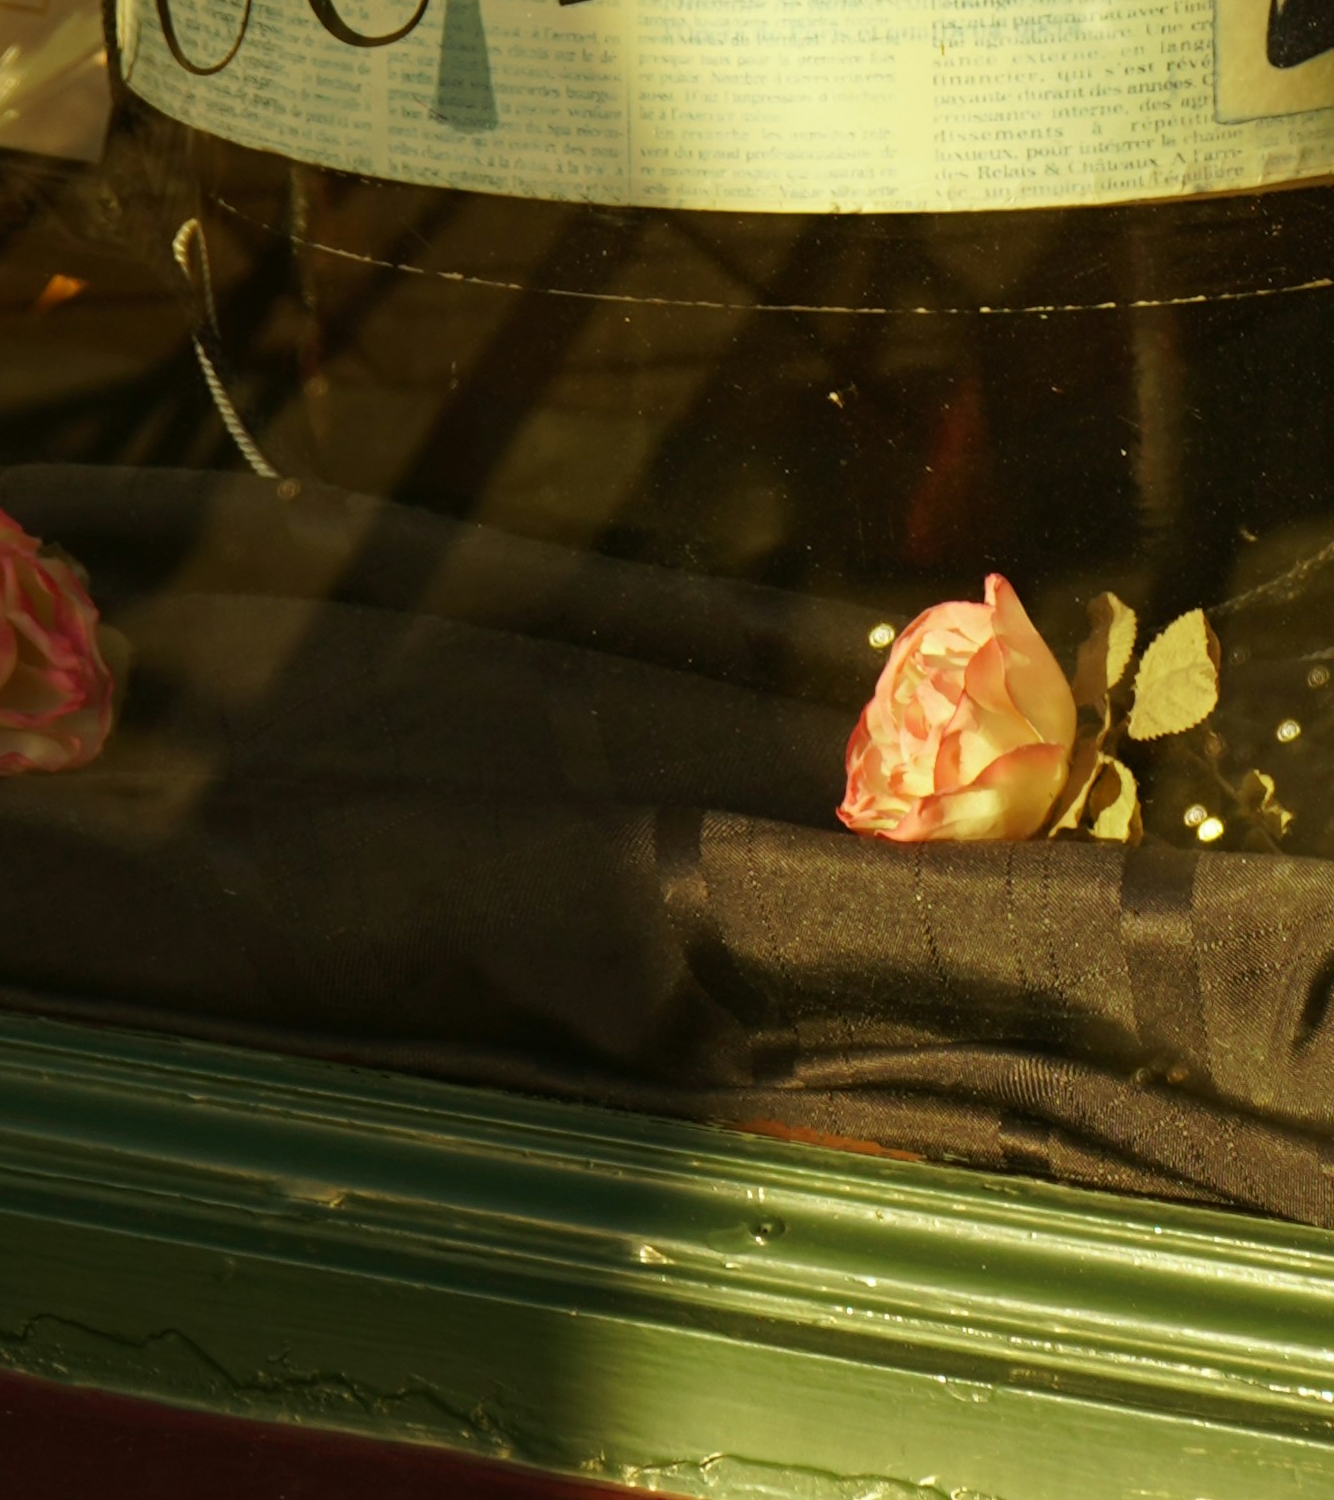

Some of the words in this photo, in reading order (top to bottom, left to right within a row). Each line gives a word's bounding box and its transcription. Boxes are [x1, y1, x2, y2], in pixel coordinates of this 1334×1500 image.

[1105, 62, 1153, 76] s'est
[1090, 84, 1121, 97] des
[1140, 99, 1172, 113] des
[978, 164, 1035, 180] Relais
